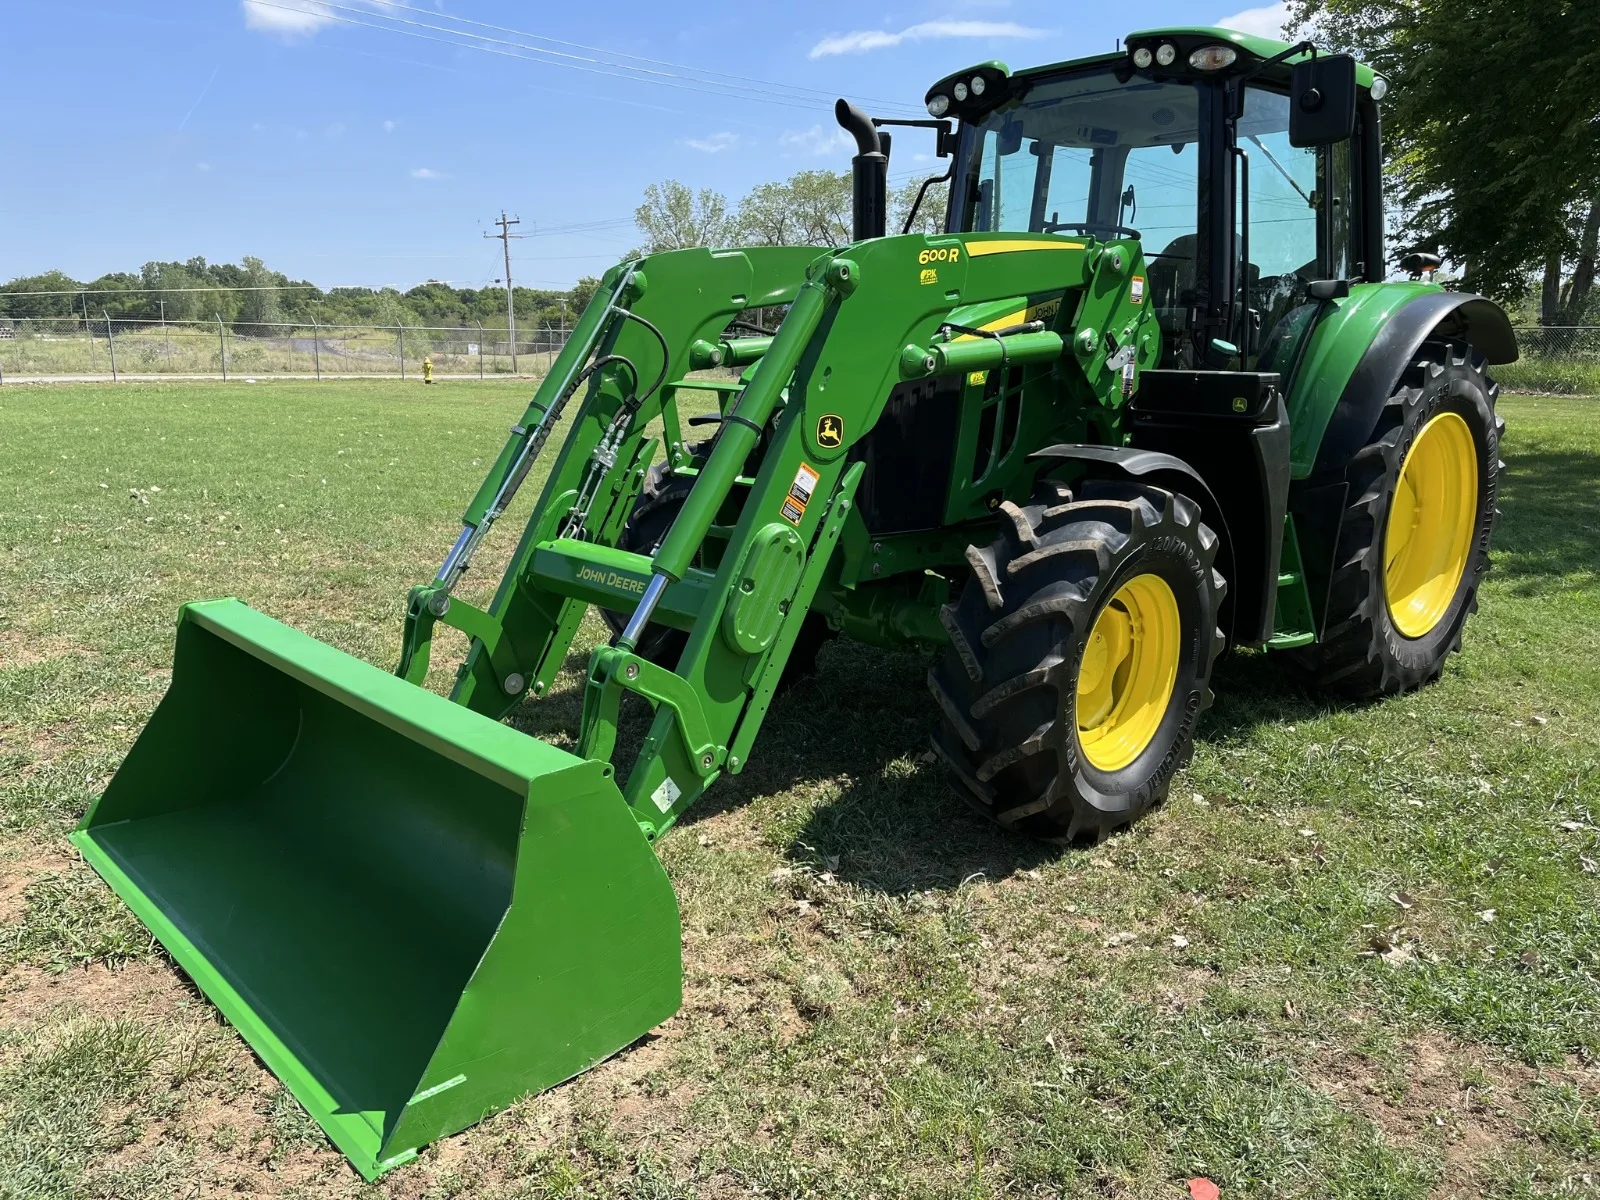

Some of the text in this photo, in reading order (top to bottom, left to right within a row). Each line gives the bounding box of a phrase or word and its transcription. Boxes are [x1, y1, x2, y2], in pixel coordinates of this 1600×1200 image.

[1033, 303, 1054, 320] JOHN
[576, 565, 646, 594] JOHN DEERE
